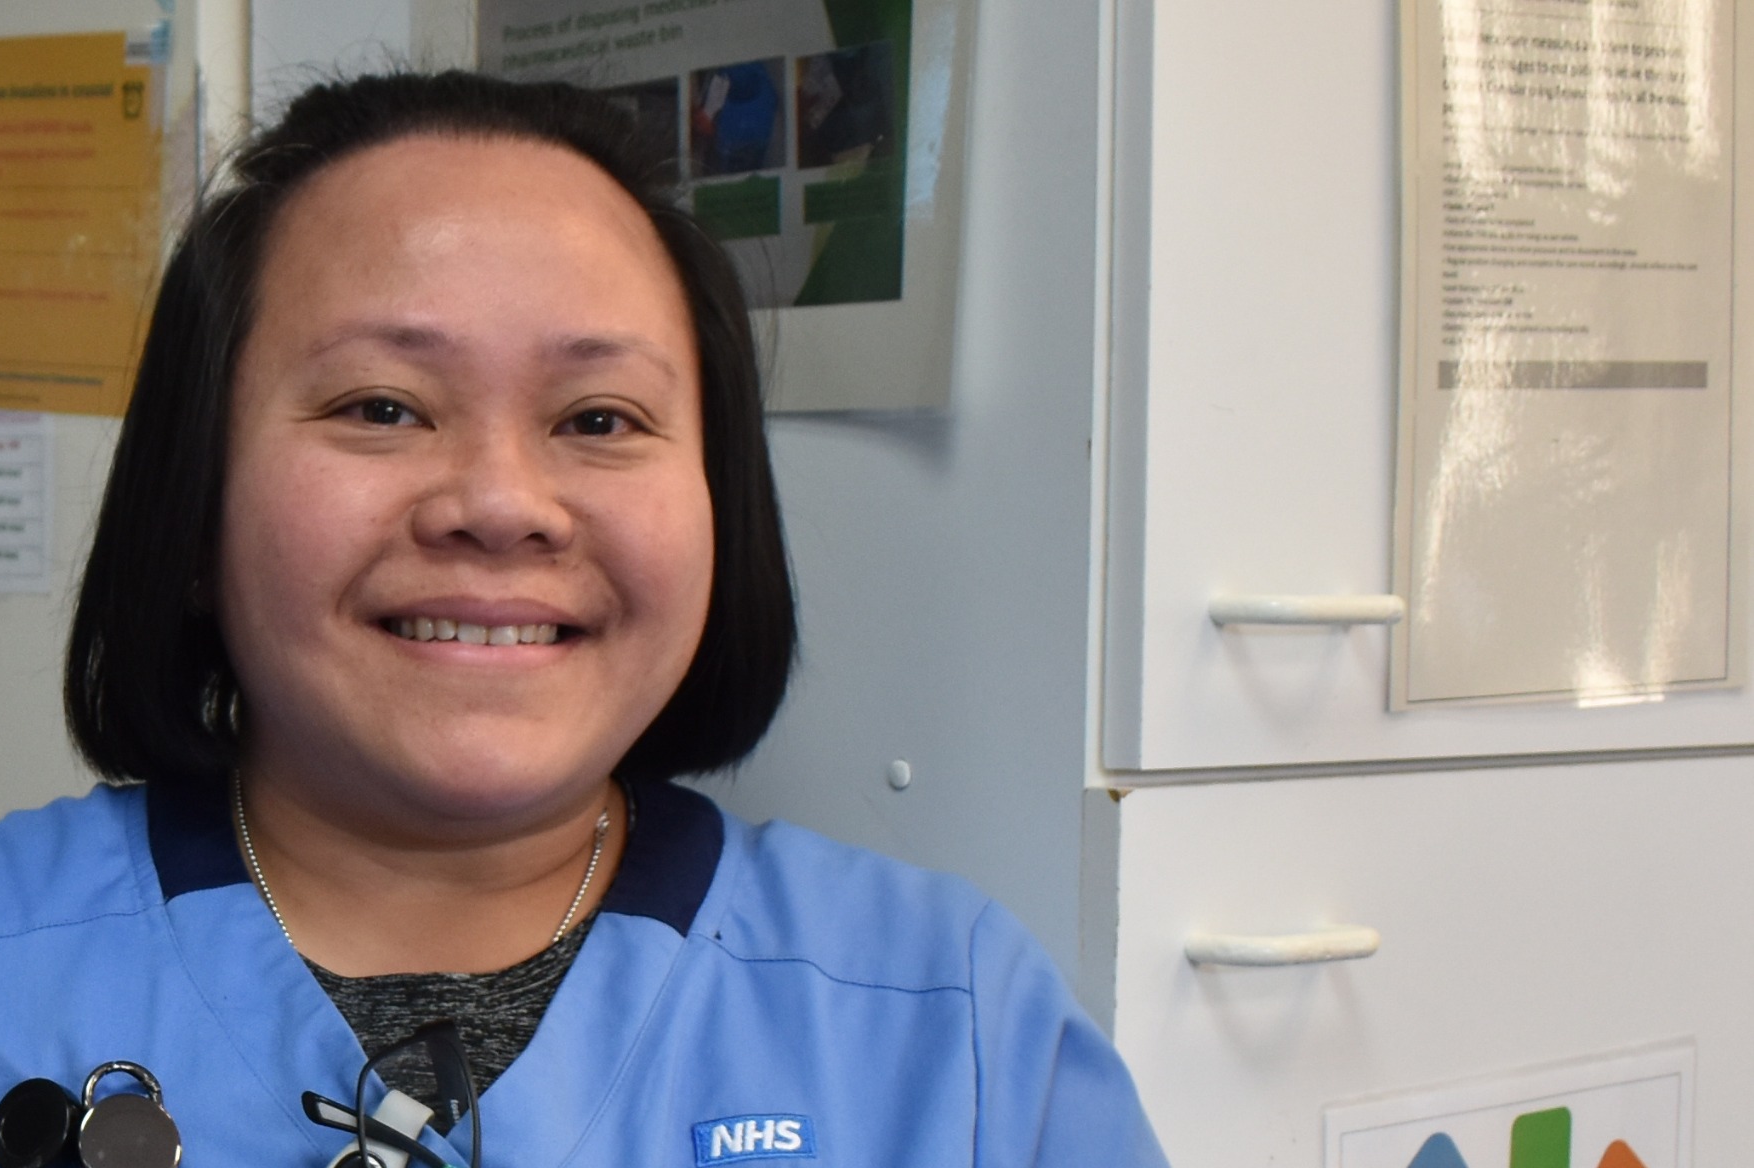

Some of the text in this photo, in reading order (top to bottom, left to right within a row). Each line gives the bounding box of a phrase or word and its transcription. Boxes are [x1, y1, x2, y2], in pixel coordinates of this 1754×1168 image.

[502, 21, 553, 43] Process
[556, 14, 572, 34] of
[614, 28, 656, 50] waste
[659, 23, 684, 43] bin
[710, 1119, 802, 1158] NHS
